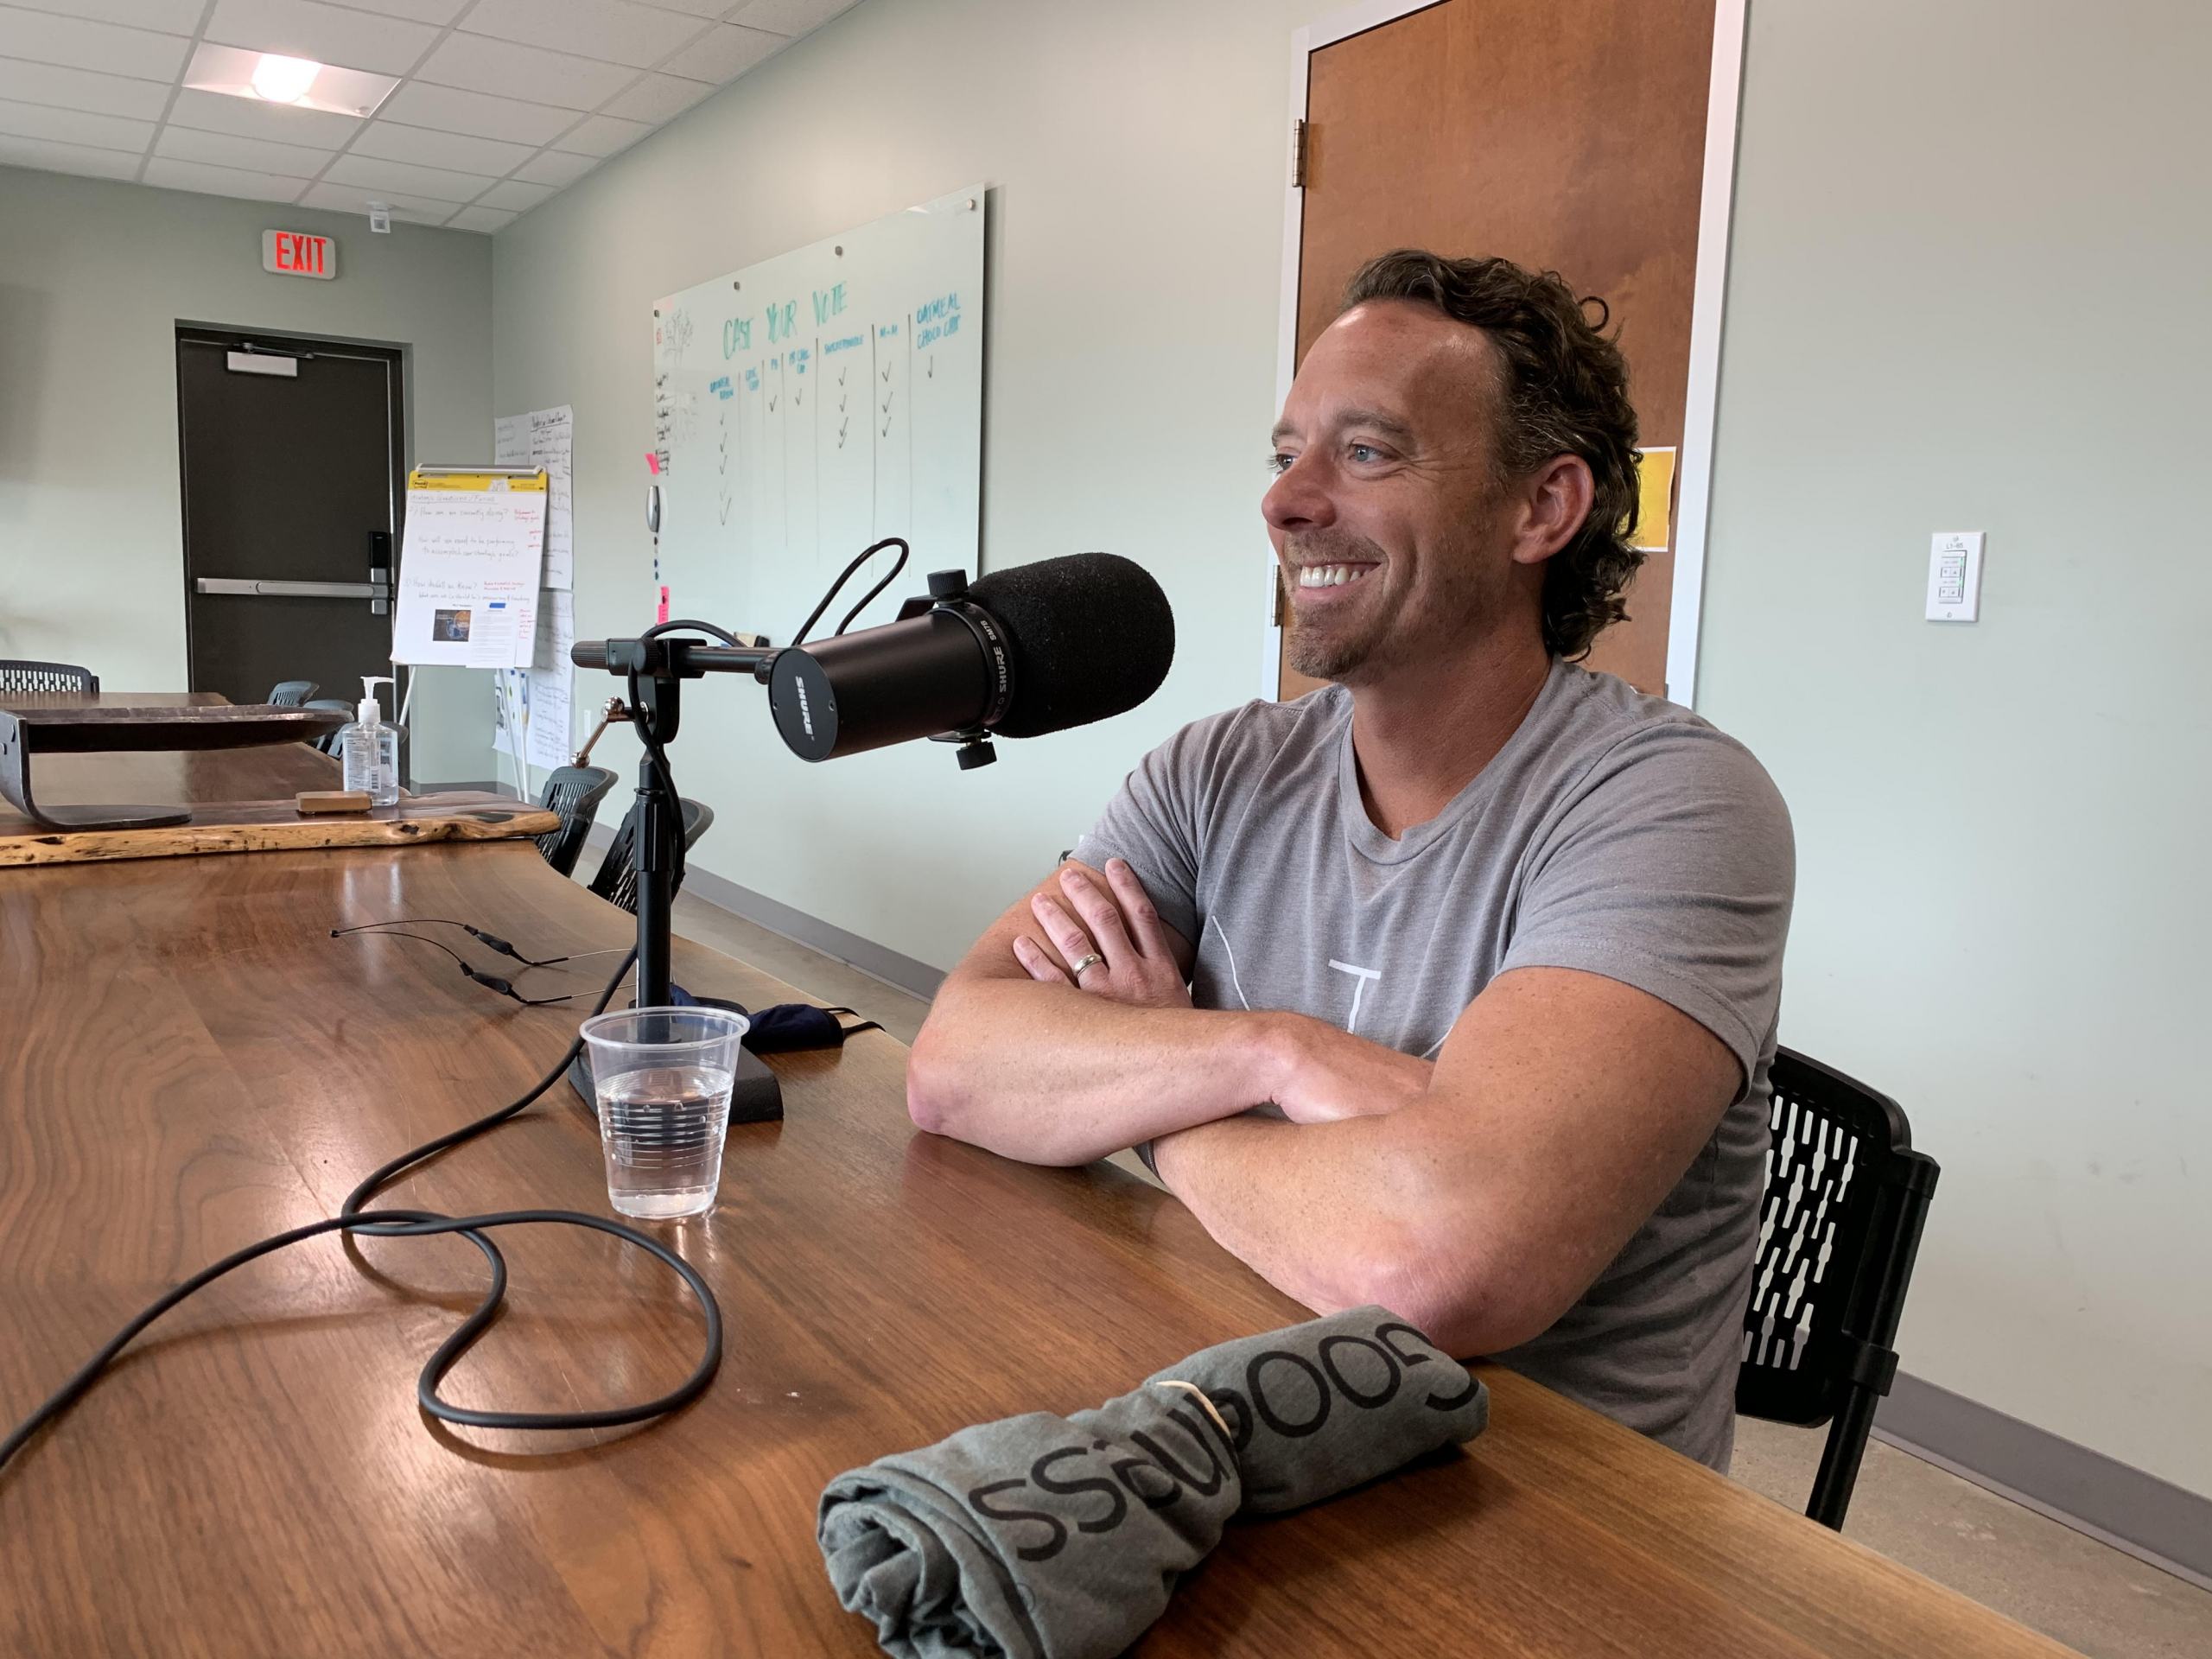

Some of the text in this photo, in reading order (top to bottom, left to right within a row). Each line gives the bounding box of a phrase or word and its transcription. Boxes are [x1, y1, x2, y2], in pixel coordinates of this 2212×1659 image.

[276, 231, 327, 276] EXIT
[723, 317, 754, 359] CAST
[811, 281, 849, 327] VOTE
[980, 620, 1007, 693] SHURE SM7B
[795, 676, 814, 735] SHURE
